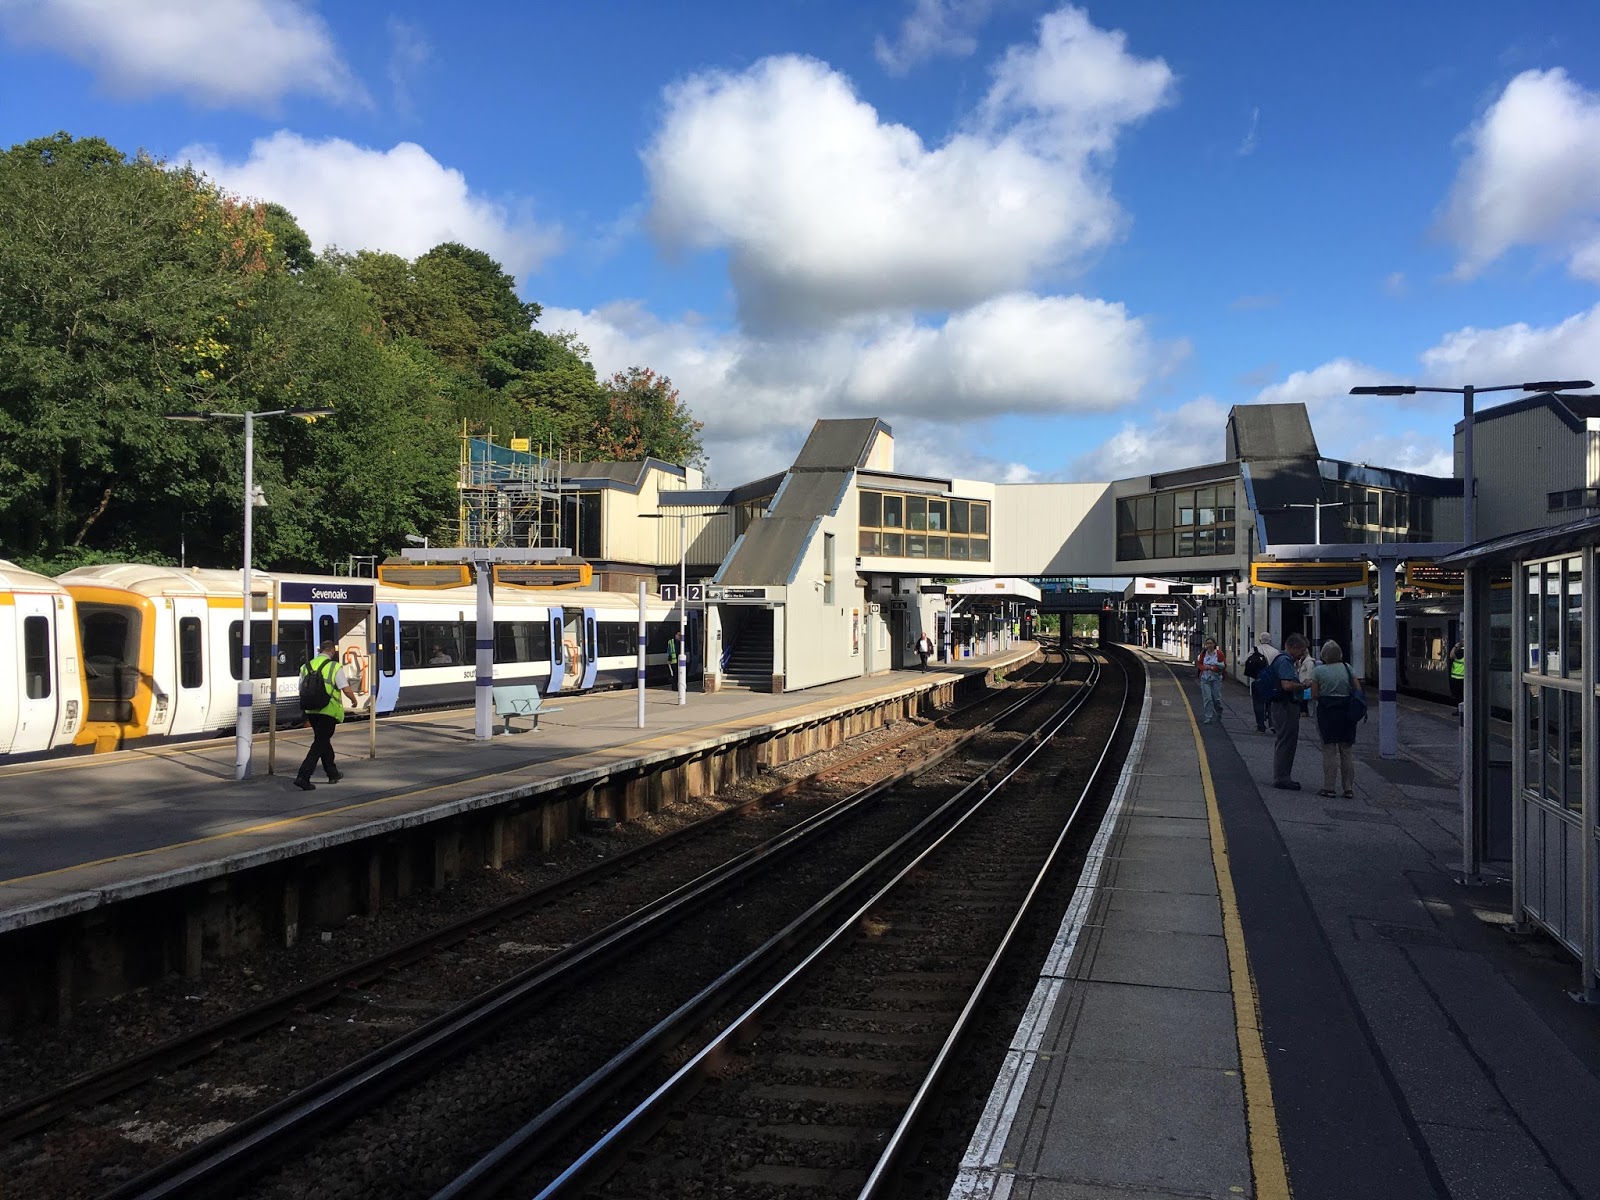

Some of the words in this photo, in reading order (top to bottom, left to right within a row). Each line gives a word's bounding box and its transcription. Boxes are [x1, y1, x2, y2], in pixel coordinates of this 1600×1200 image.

[311, 587, 348, 600] Sevenoaks
[665, 587, 671, 600] 1
[691, 587, 700, 600] 2
[278, 681, 298, 693] class
